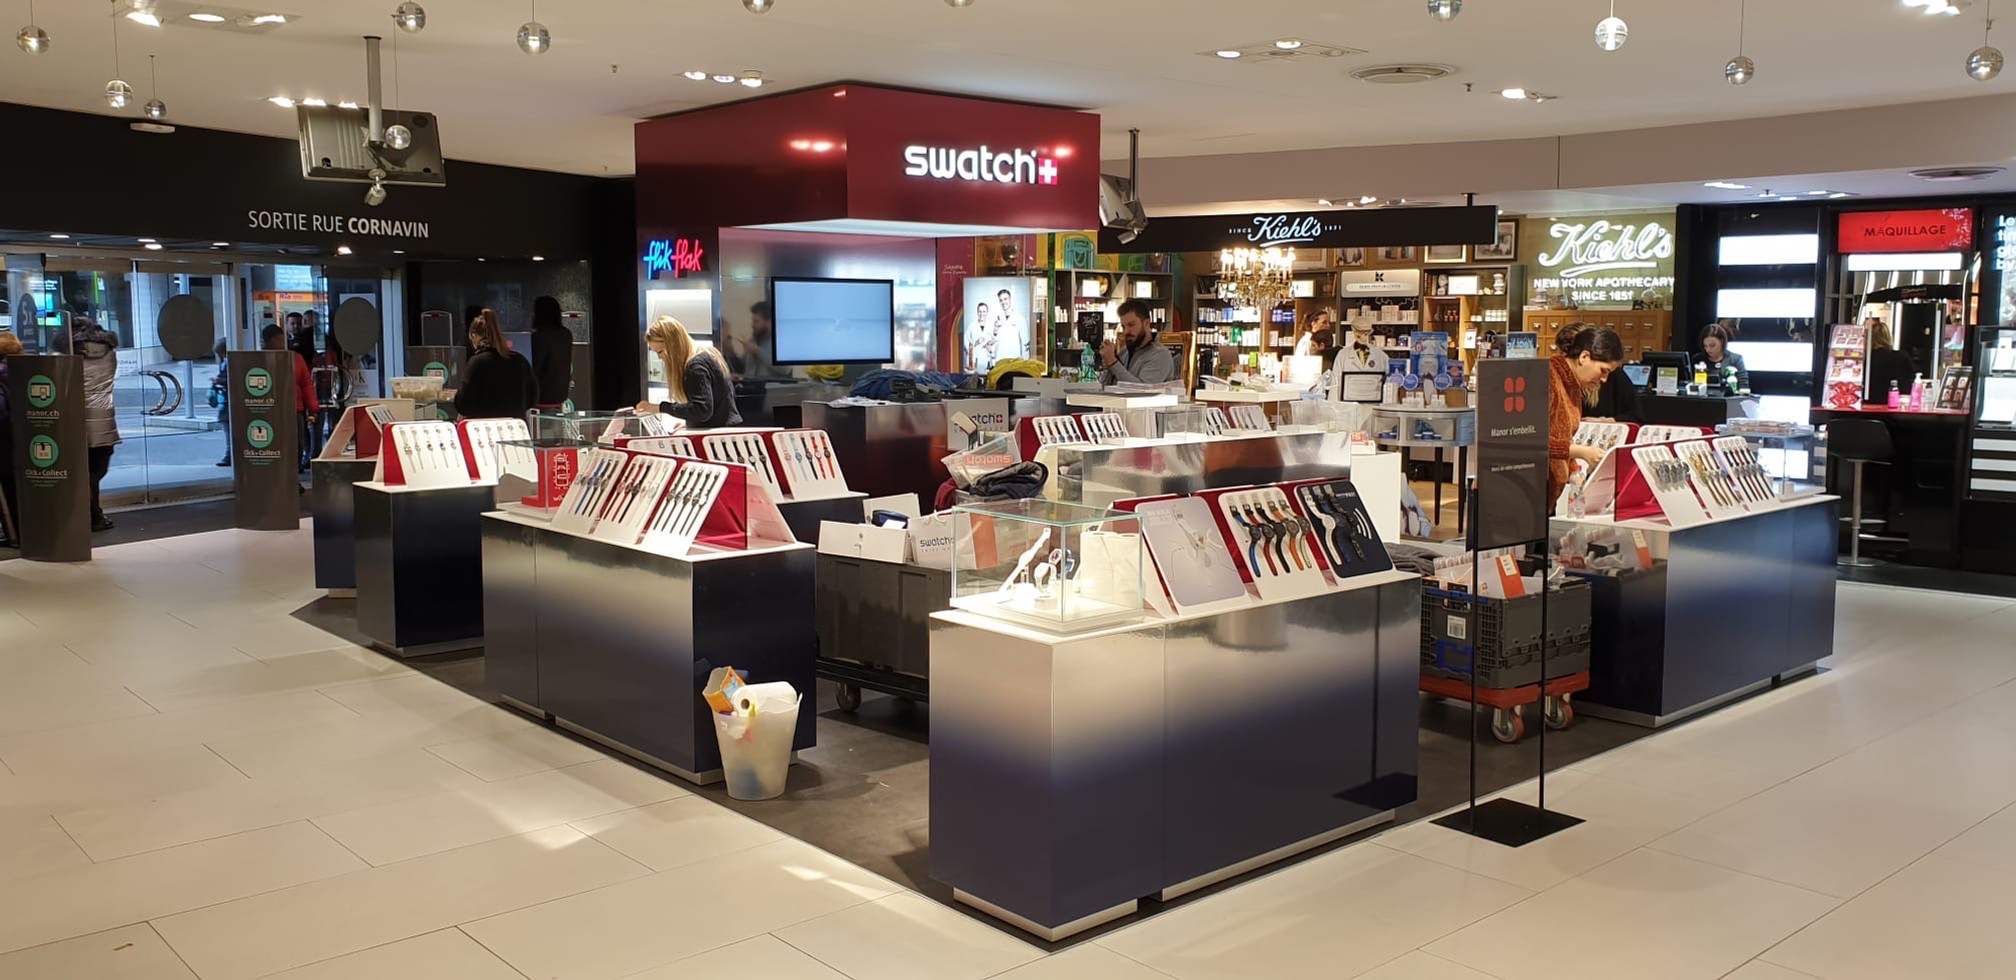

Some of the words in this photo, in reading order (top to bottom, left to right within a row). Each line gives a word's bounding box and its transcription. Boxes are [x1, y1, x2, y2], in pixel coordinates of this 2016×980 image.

[904, 145, 1037, 184] swatch
[248, 210, 308, 231] SORTIE
[312, 214, 344, 233] RUE
[347, 216, 430, 239] CORNAVIN
[1247, 215, 1321, 242] Kiehl's
[1864, 225, 1947, 237] MAQUILLAGE
[1538, 220, 1674, 267] Kiehl's
[643, 239, 673, 280] flik
[670, 238, 704, 279] flak
[1534, 278, 1560, 289] NEW
[1561, 278, 1593, 289] YORK
[1594, 276, 1675, 288] APOTHECARY
[1571, 290, 1607, 301] SINCE
[1609, 290, 1635, 301] 1851
[919, 536, 951, 548] swatch
